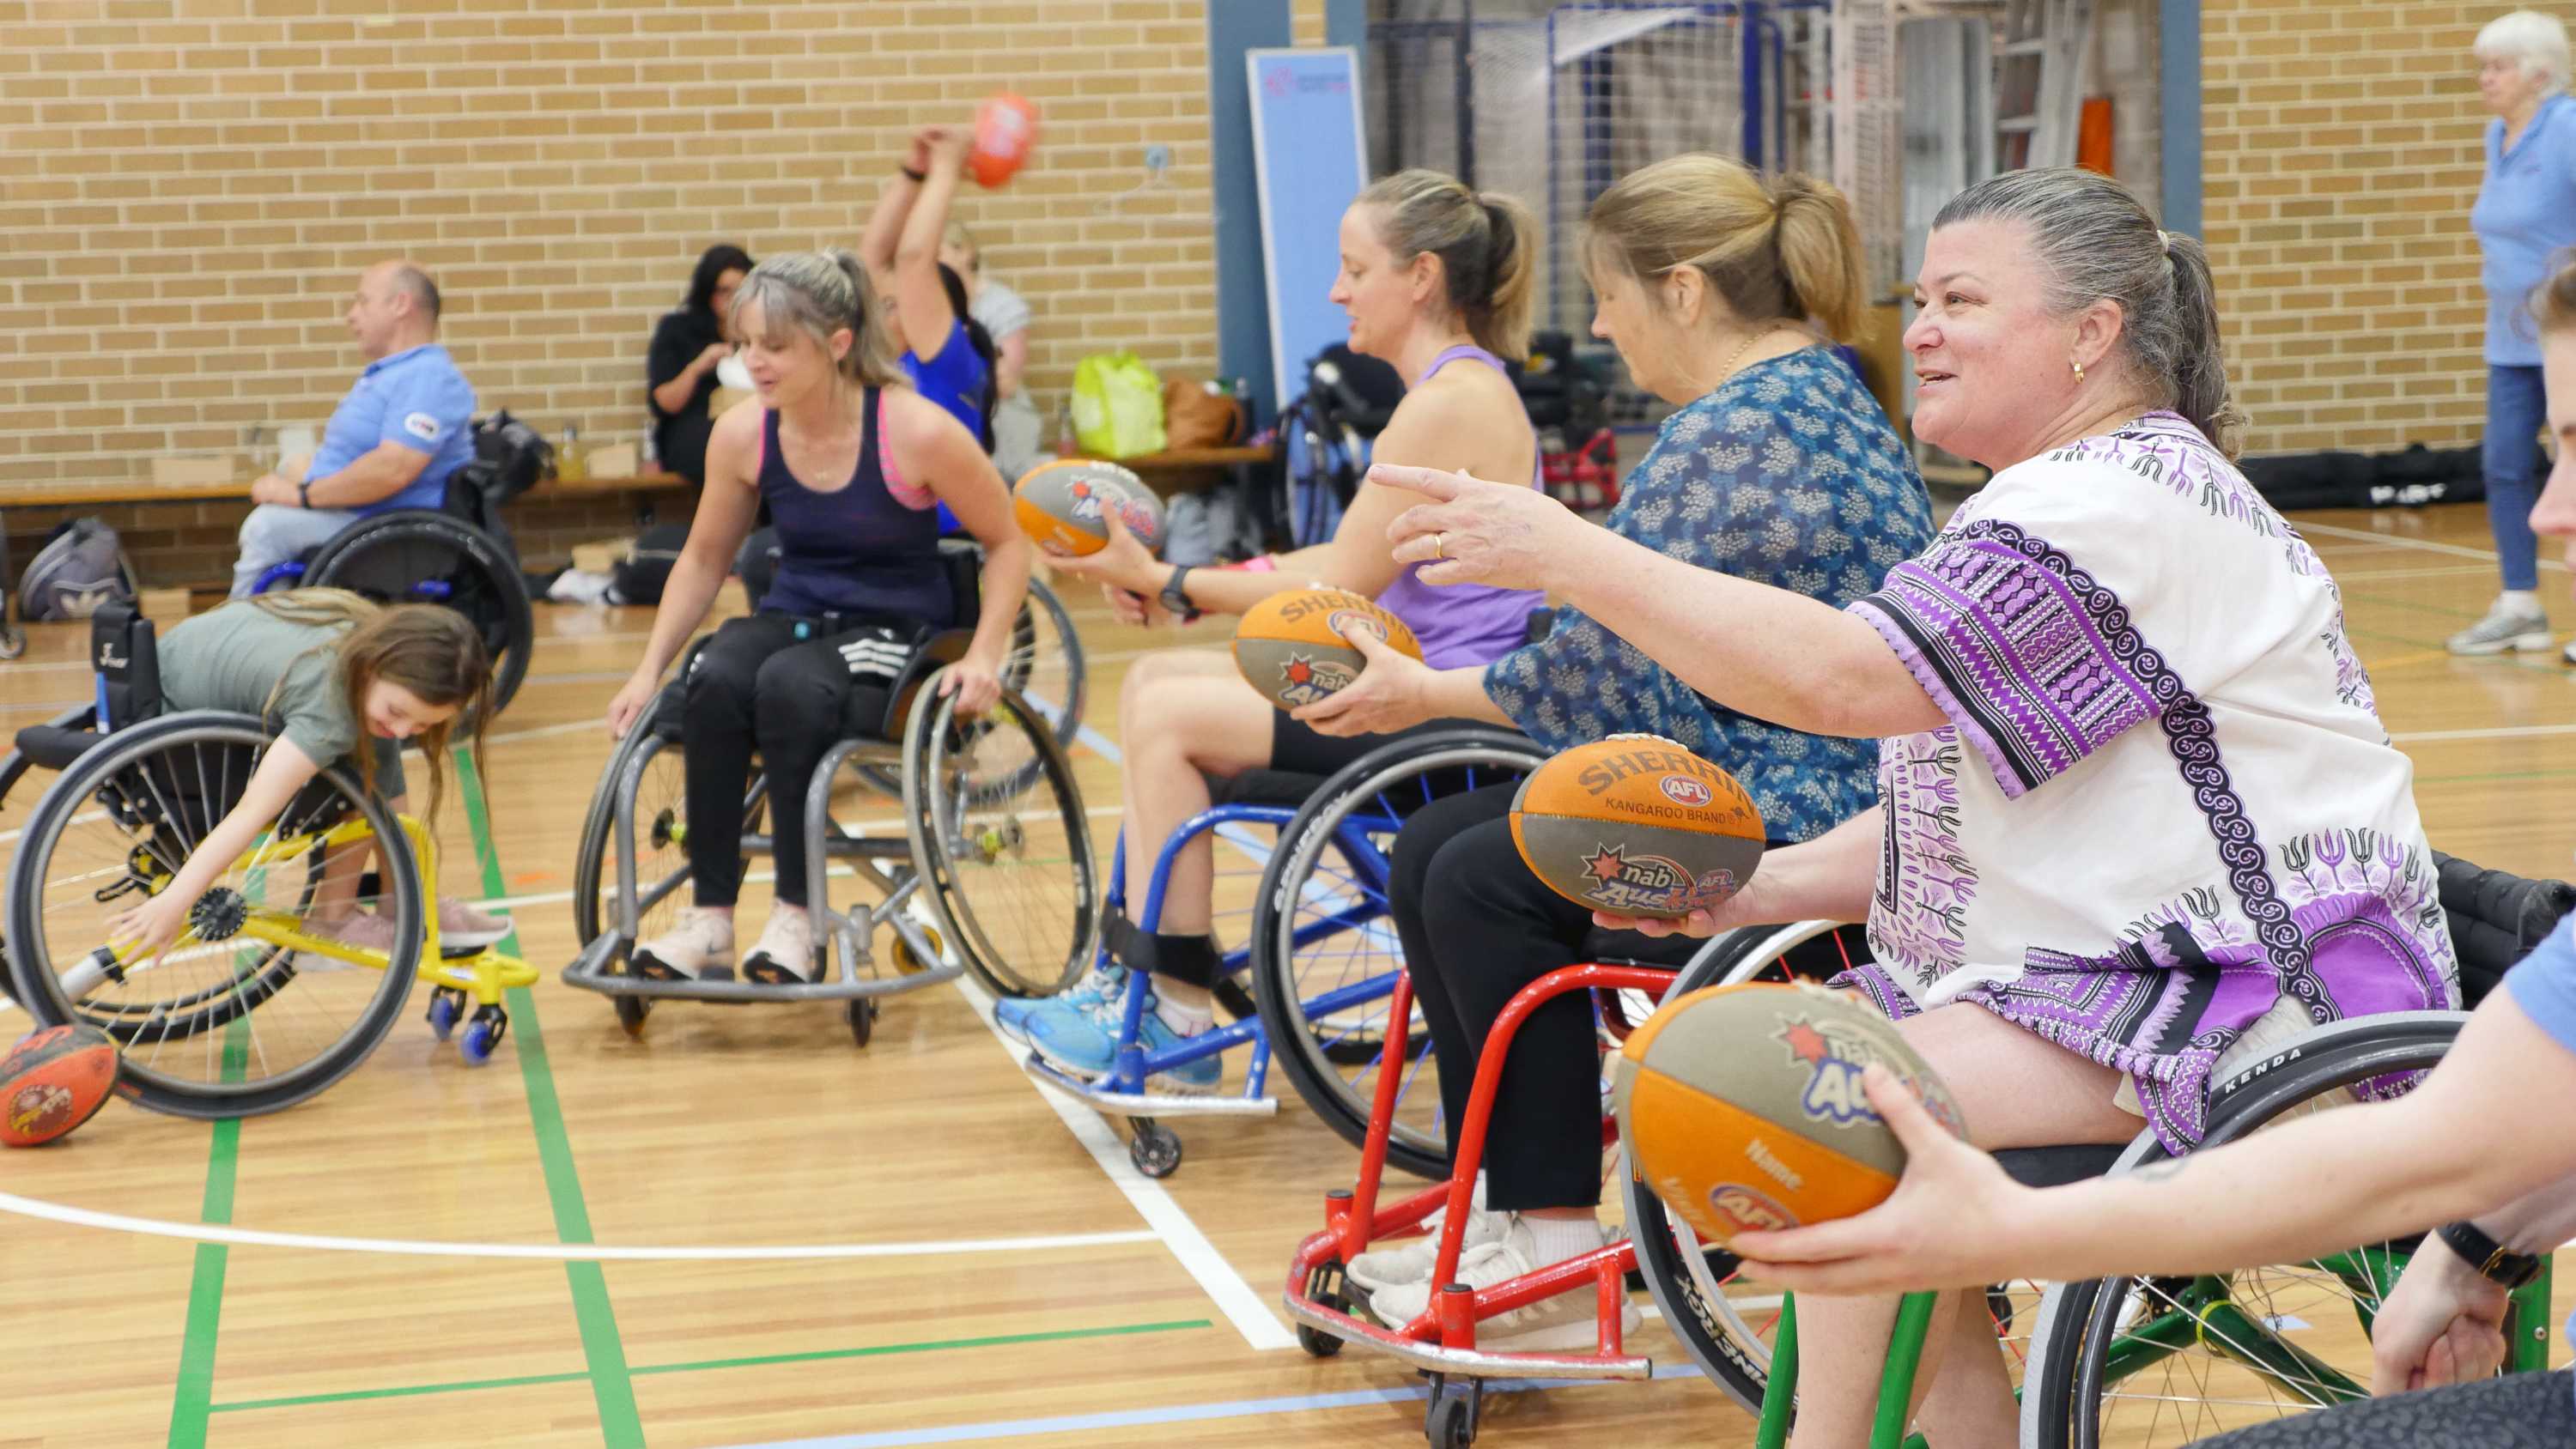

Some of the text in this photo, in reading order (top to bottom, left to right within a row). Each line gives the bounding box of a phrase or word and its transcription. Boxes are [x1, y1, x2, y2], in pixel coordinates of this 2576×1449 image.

[1578, 750, 1755, 816] SHERRIN
[1668, 779, 1710, 801] AFL
[1605, 797, 1684, 819] KANGAROO
[1624, 867, 1671, 888] nab
[2225, 1048, 2301, 1094] KENDA
[1745, 1138, 1802, 1191] Name
